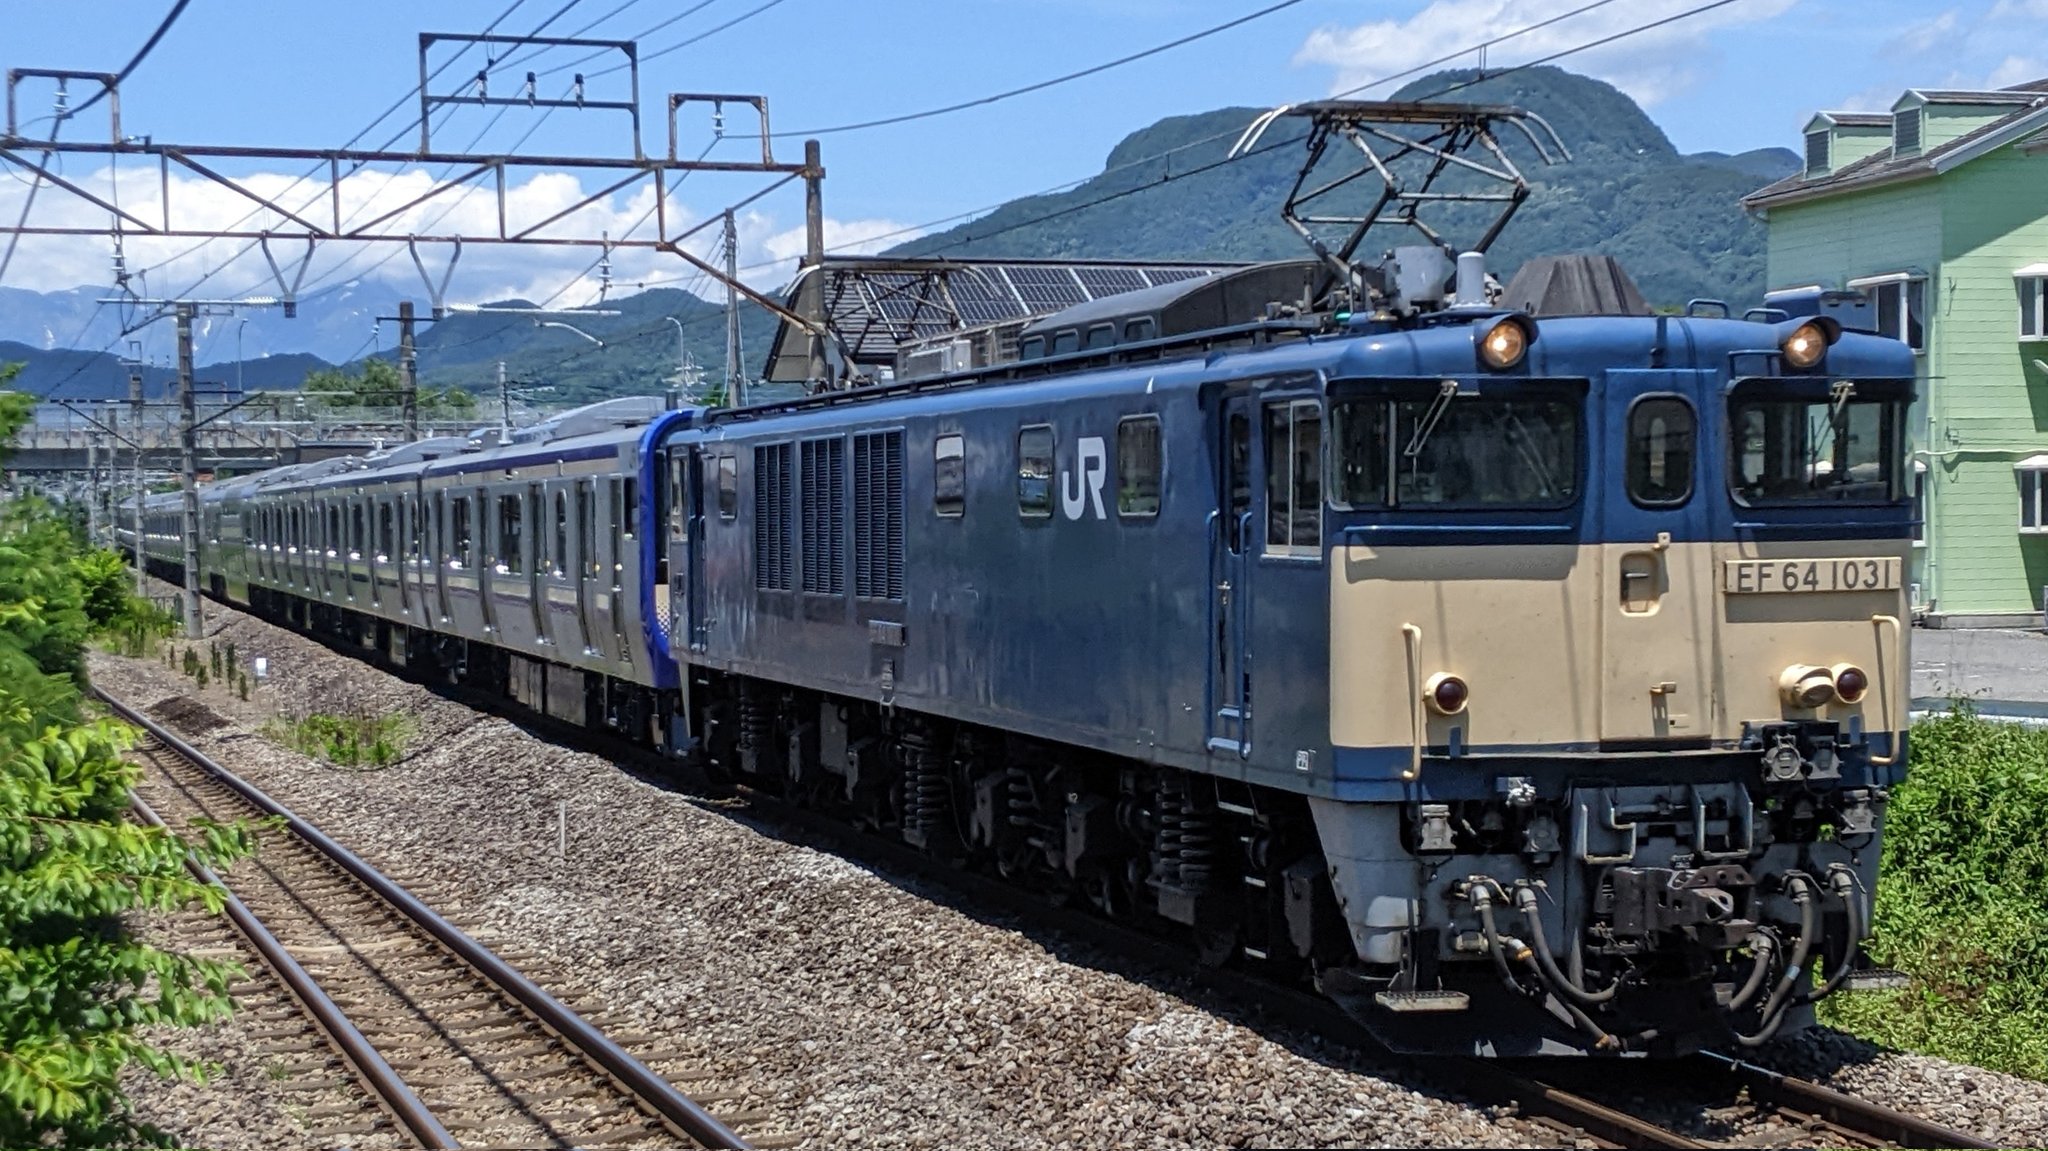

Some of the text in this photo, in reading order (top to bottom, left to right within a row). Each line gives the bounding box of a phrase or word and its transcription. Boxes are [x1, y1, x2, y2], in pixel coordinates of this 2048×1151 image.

[1062, 437, 1107, 520] JR
[1738, 559, 1890, 592] EF 64 1031
